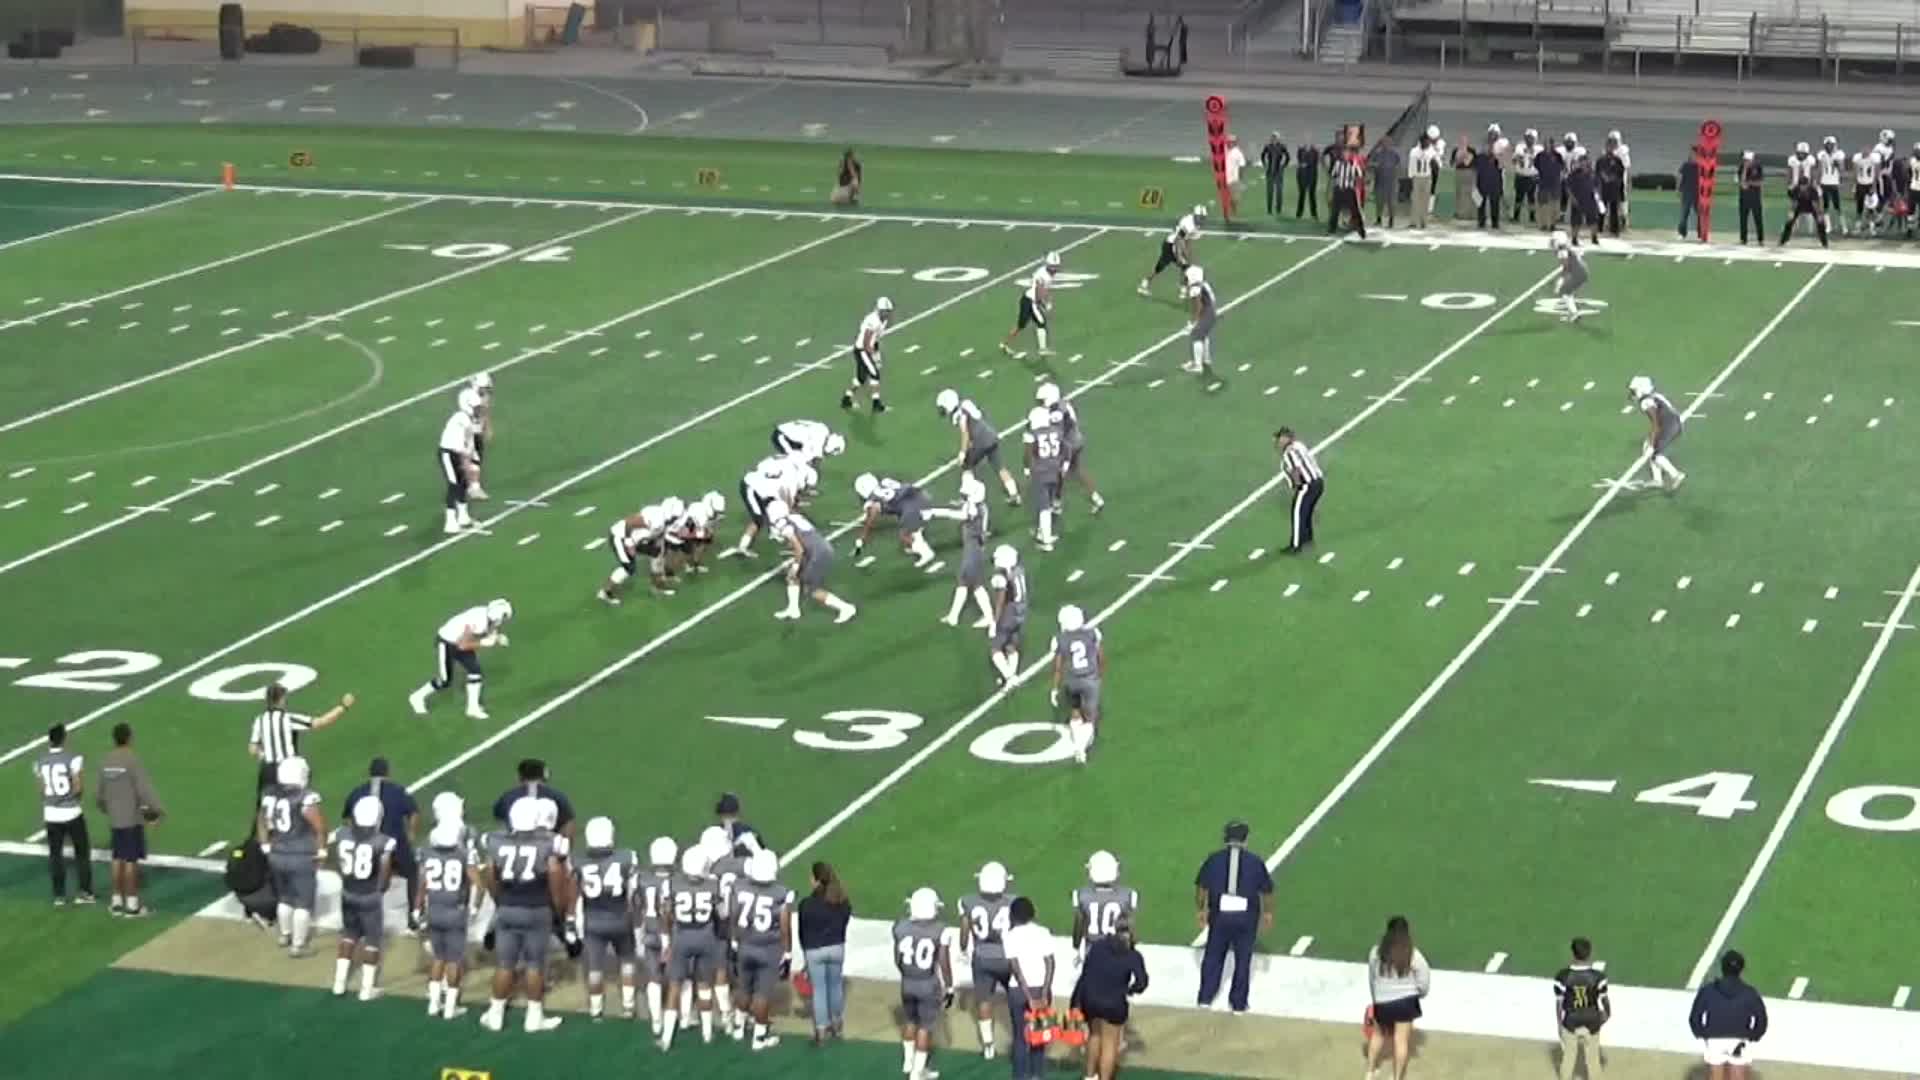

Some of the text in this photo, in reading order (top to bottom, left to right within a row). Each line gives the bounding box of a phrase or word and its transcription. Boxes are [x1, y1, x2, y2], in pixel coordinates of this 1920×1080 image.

[1037, 433, 1060, 458] 55
[1070, 641, 1088, 670] 2
[41, 762, 70, 796] 16
[261, 796, 291, 832] 73
[339, 839, 373, 880] 58
[425, 858, 462, 892] 28
[499, 845, 537, 880] 77
[582, 862, 623, 898] 54
[675, 891, 712, 922] 25
[737, 891, 773, 931] 75
[971, 906, 1010, 940] 34
[1088, 902, 1121, 935] 10
[899, 936, 935, 970] 40
